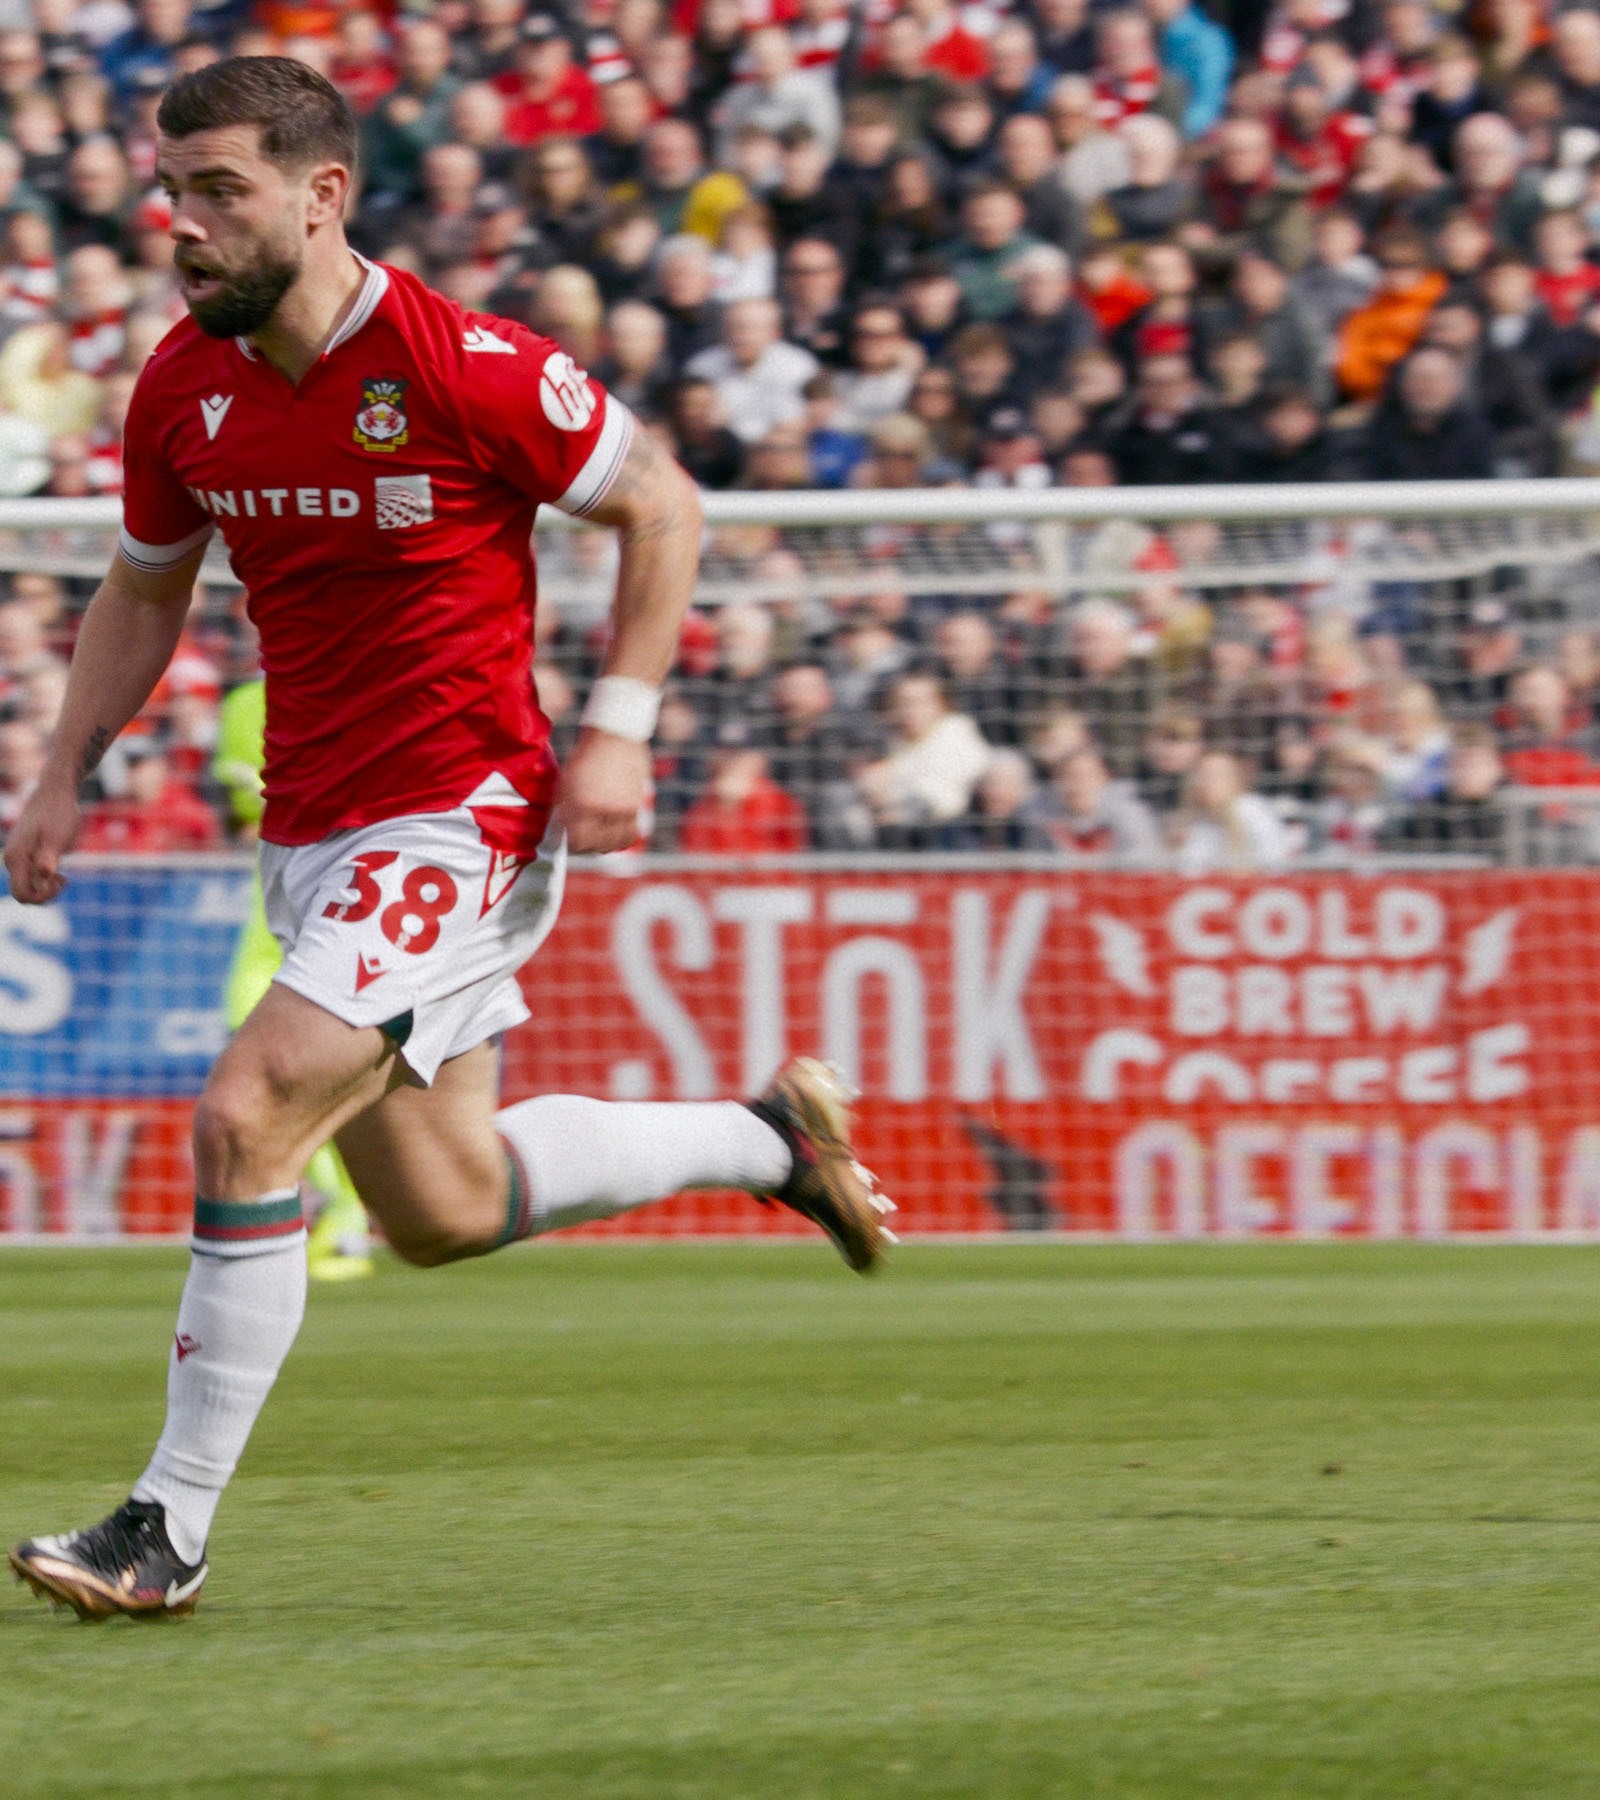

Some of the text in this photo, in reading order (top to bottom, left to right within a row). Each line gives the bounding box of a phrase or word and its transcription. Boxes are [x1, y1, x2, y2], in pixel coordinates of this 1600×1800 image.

[321, 850, 459, 955] 38
[1166, 886, 1447, 960] COLD
[1168, 964, 1450, 1036] BREW
